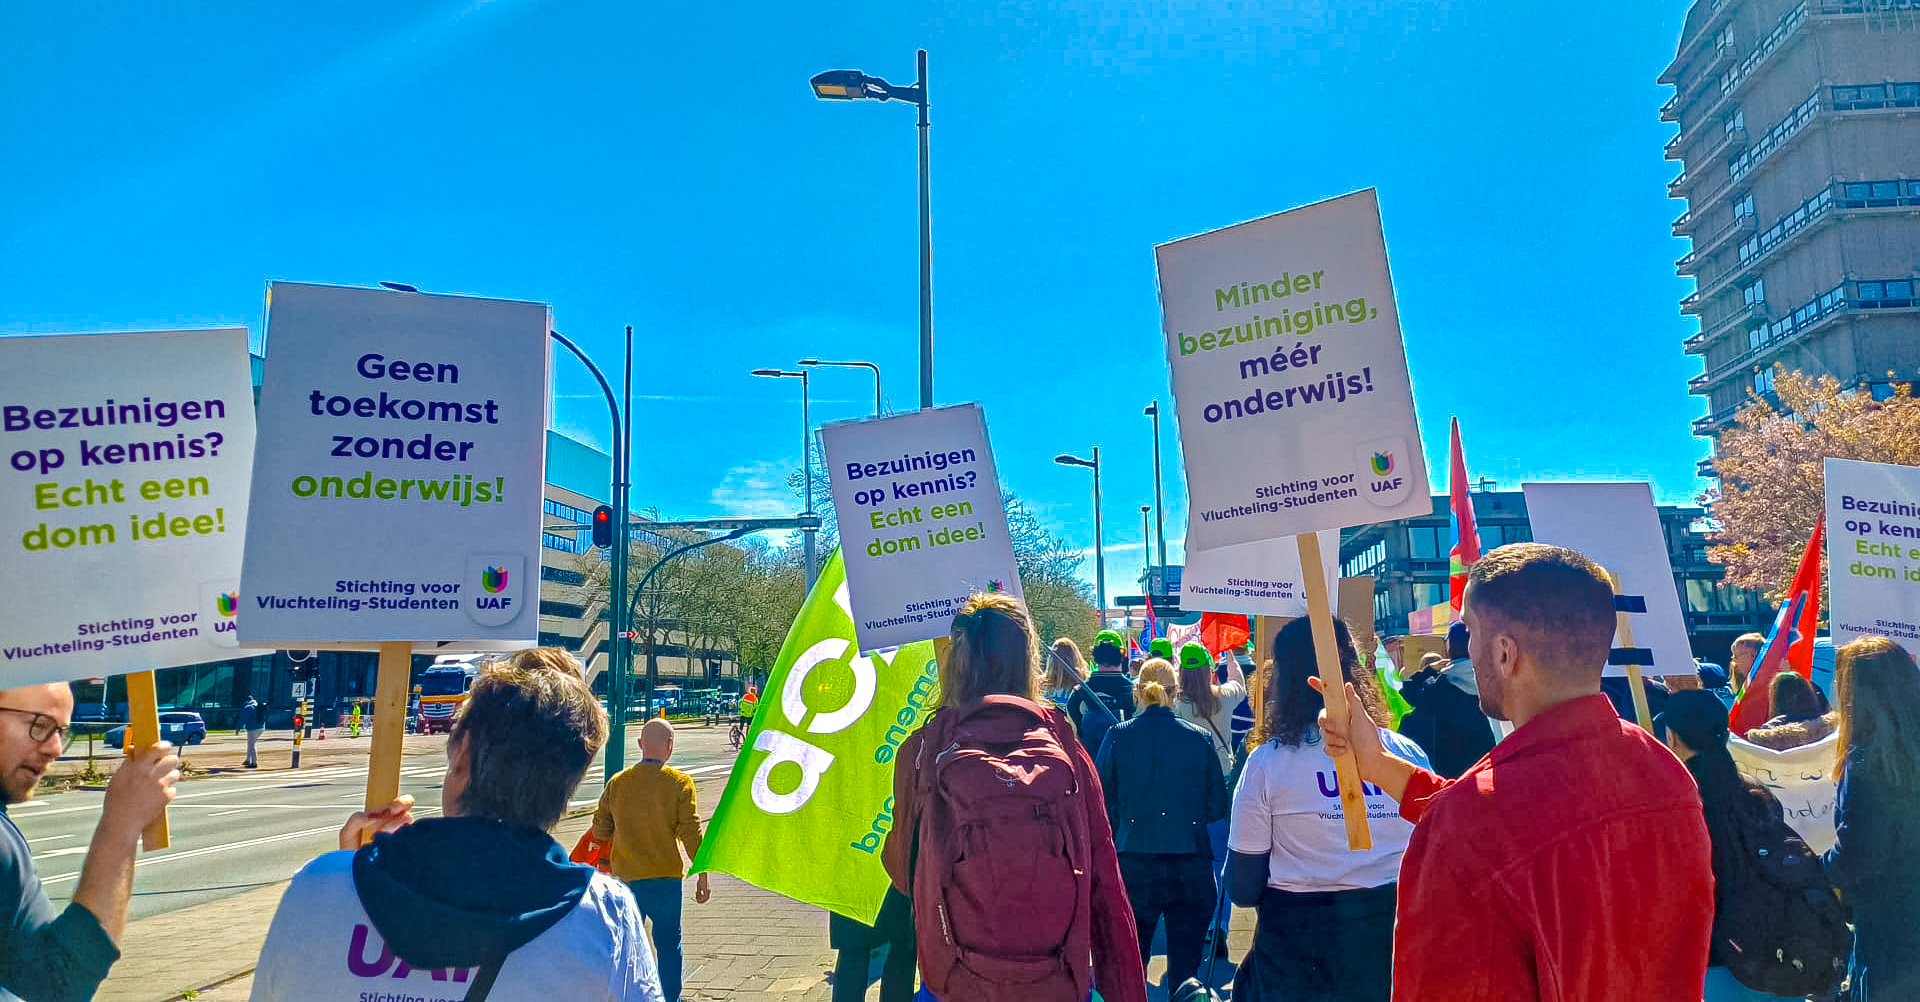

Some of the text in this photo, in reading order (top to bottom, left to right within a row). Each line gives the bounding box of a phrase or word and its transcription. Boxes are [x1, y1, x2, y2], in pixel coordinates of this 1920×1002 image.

[1215, 268, 1324, 311] Minder
[1178, 296, 1378, 355] bezuiniging,
[357, 353, 459, 384] Geen
[1239, 342, 1322, 379] méér
[310, 390, 499, 425] toekomst
[1203, 367, 1374, 423] onderwijs!
[2, 397, 226, 432] Bezuinigen
[11, 432, 224, 474] op kennis?
[331, 431, 474, 462] zonder
[846, 448, 976, 481] Bezuinigen
[34, 475, 209, 510] Echt een
[292, 472, 505, 506] onderwijs!
[854, 470, 977, 507] op kennis?
[1255, 473, 1355, 499] Stichting voor
[1371, 477, 1403, 494] UAF
[869, 501, 973, 530] Echt een
[1201, 486, 1358, 523] Vluchteling-Studenten
[22, 508, 225, 551] dom idee!
[866, 522, 986, 557] dom idee!
[1845, 520, 1871, 535] op
[1856, 539, 1902, 558] Echt
[1227, 578, 1293, 589] Stichting voor
[1849, 560, 1896, 578] dom
[256, 595, 460, 612] Vluchteling-Studenten
[335, 580, 461, 597] Stichting voor
[476, 597, 512, 610] UAF
[1189, 585, 1292, 598] Vluchteling-Studenten
[865, 606, 962, 629] Vluchteling-Studen
[906, 596, 970, 613] Stichting voo
[78, 613, 198, 636] Stichting voor
[215, 621, 237, 633] UA
[1840, 623, 1920, 639] Vluchteling-Stude
[1874, 620, 1916, 631] Stichting
[3, 627, 198, 660] Vluchteling-Studenten
